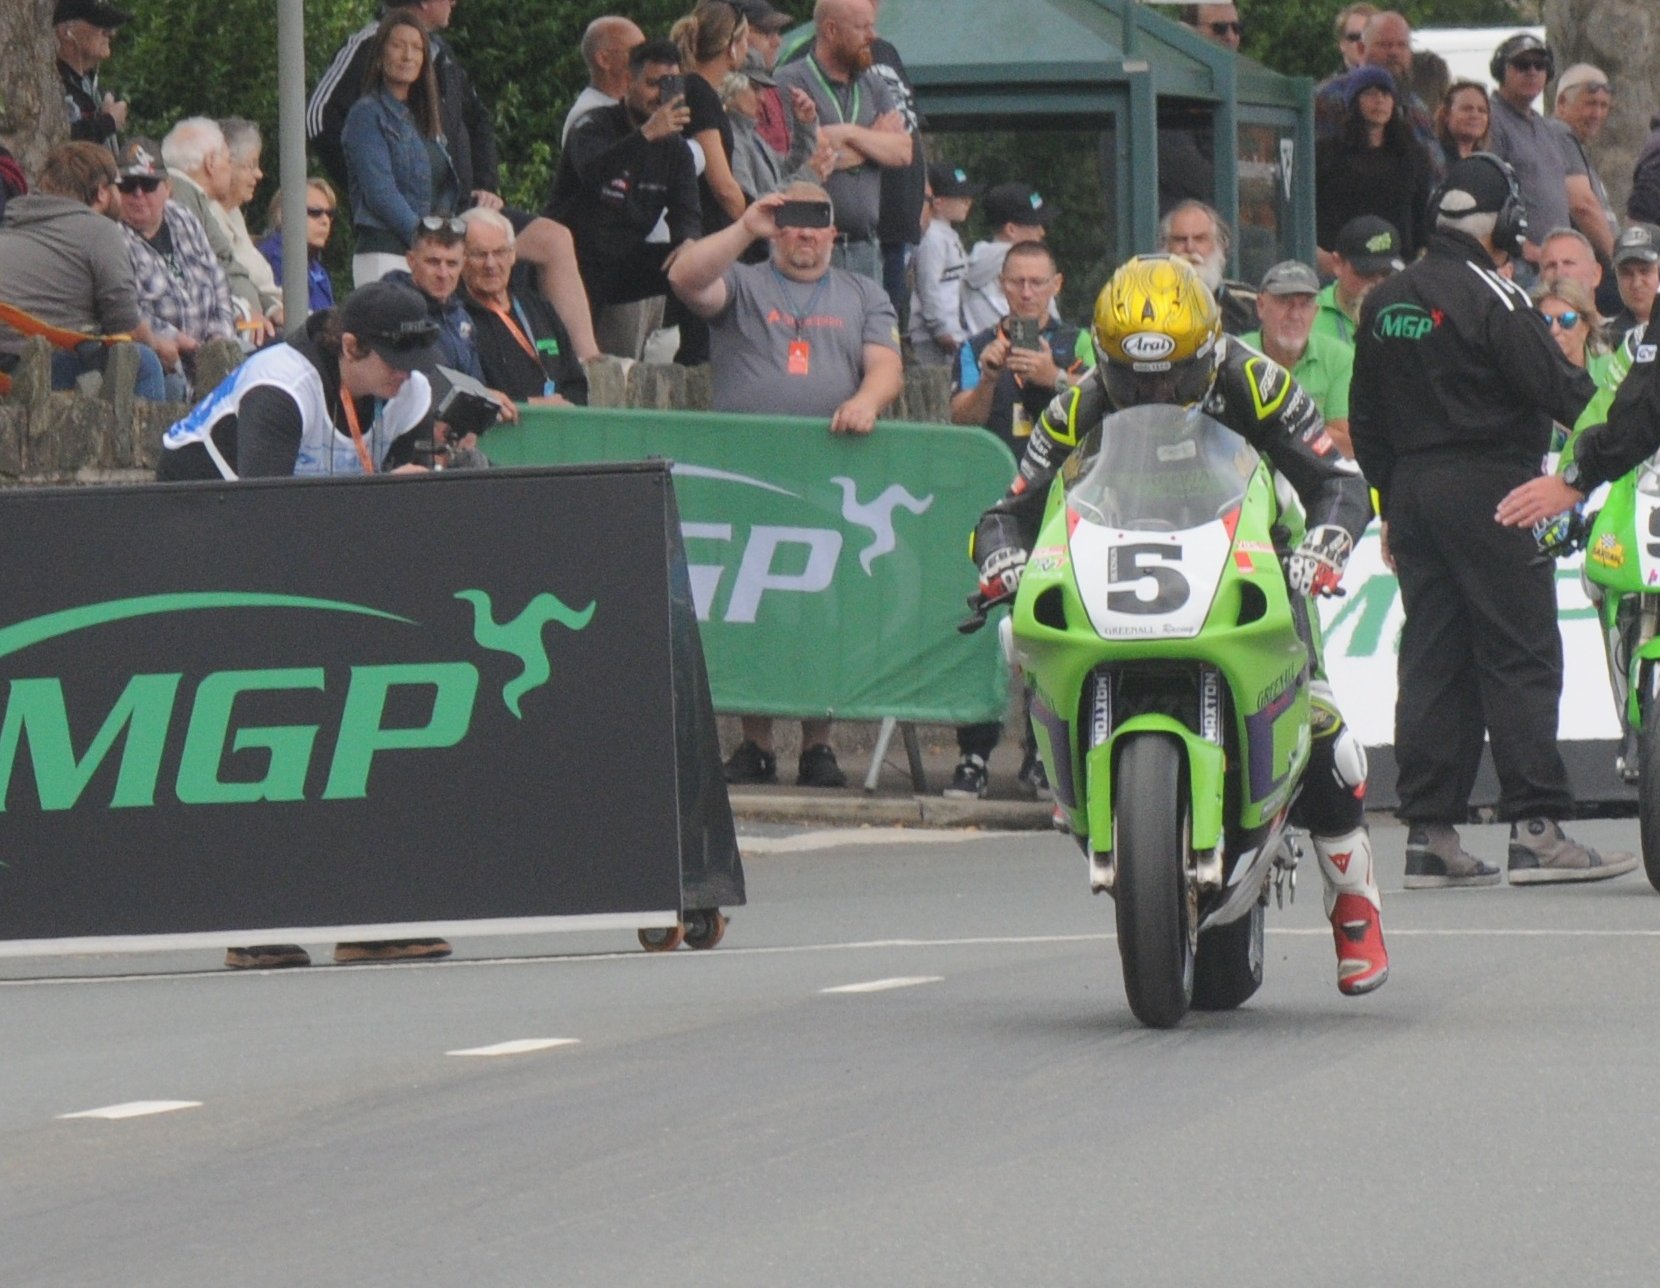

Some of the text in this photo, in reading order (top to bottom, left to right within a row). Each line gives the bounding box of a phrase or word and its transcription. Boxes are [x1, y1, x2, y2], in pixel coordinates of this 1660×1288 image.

[1126, 336, 1167, 352] Arai
[1381, 313, 1433, 339] MGP
[1107, 543, 1191, 616] 5
[0, 661, 479, 812] MGP
[1094, 675, 1108, 746] MAXTON
[1203, 671, 1218, 743] MAXTON
